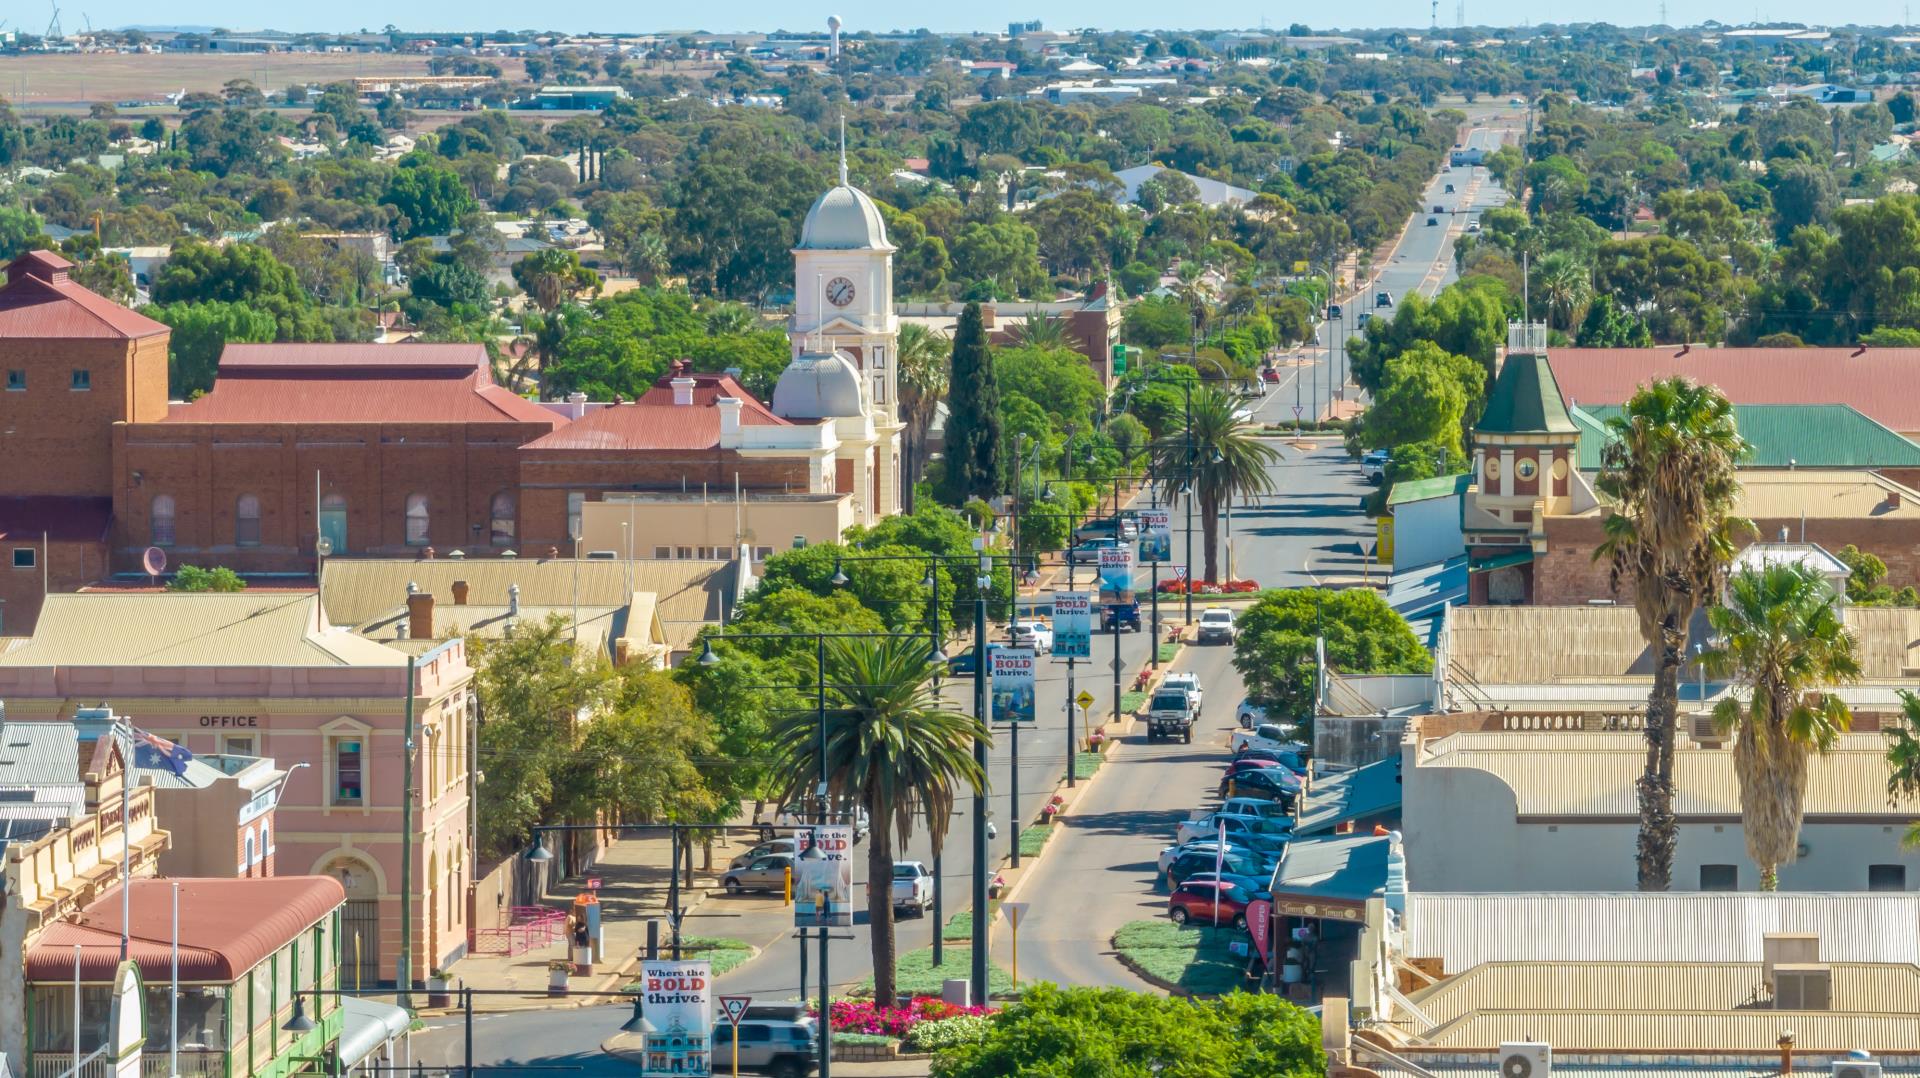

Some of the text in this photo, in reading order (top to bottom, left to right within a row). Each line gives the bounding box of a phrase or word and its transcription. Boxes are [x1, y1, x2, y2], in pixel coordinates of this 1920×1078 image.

[1056, 600, 1088, 608] BOLD
[1056, 608, 1089, 616] thrive.
[995, 660, 1032, 668] BOLD
[995, 669, 1033, 677] thrive.
[199, 715, 257, 727] OFFICE
[799, 831, 847, 839] Were the
[647, 969, 705, 977] Where the
[647, 978, 705, 992] BOLD
[647, 992, 706, 1004] thrive.
